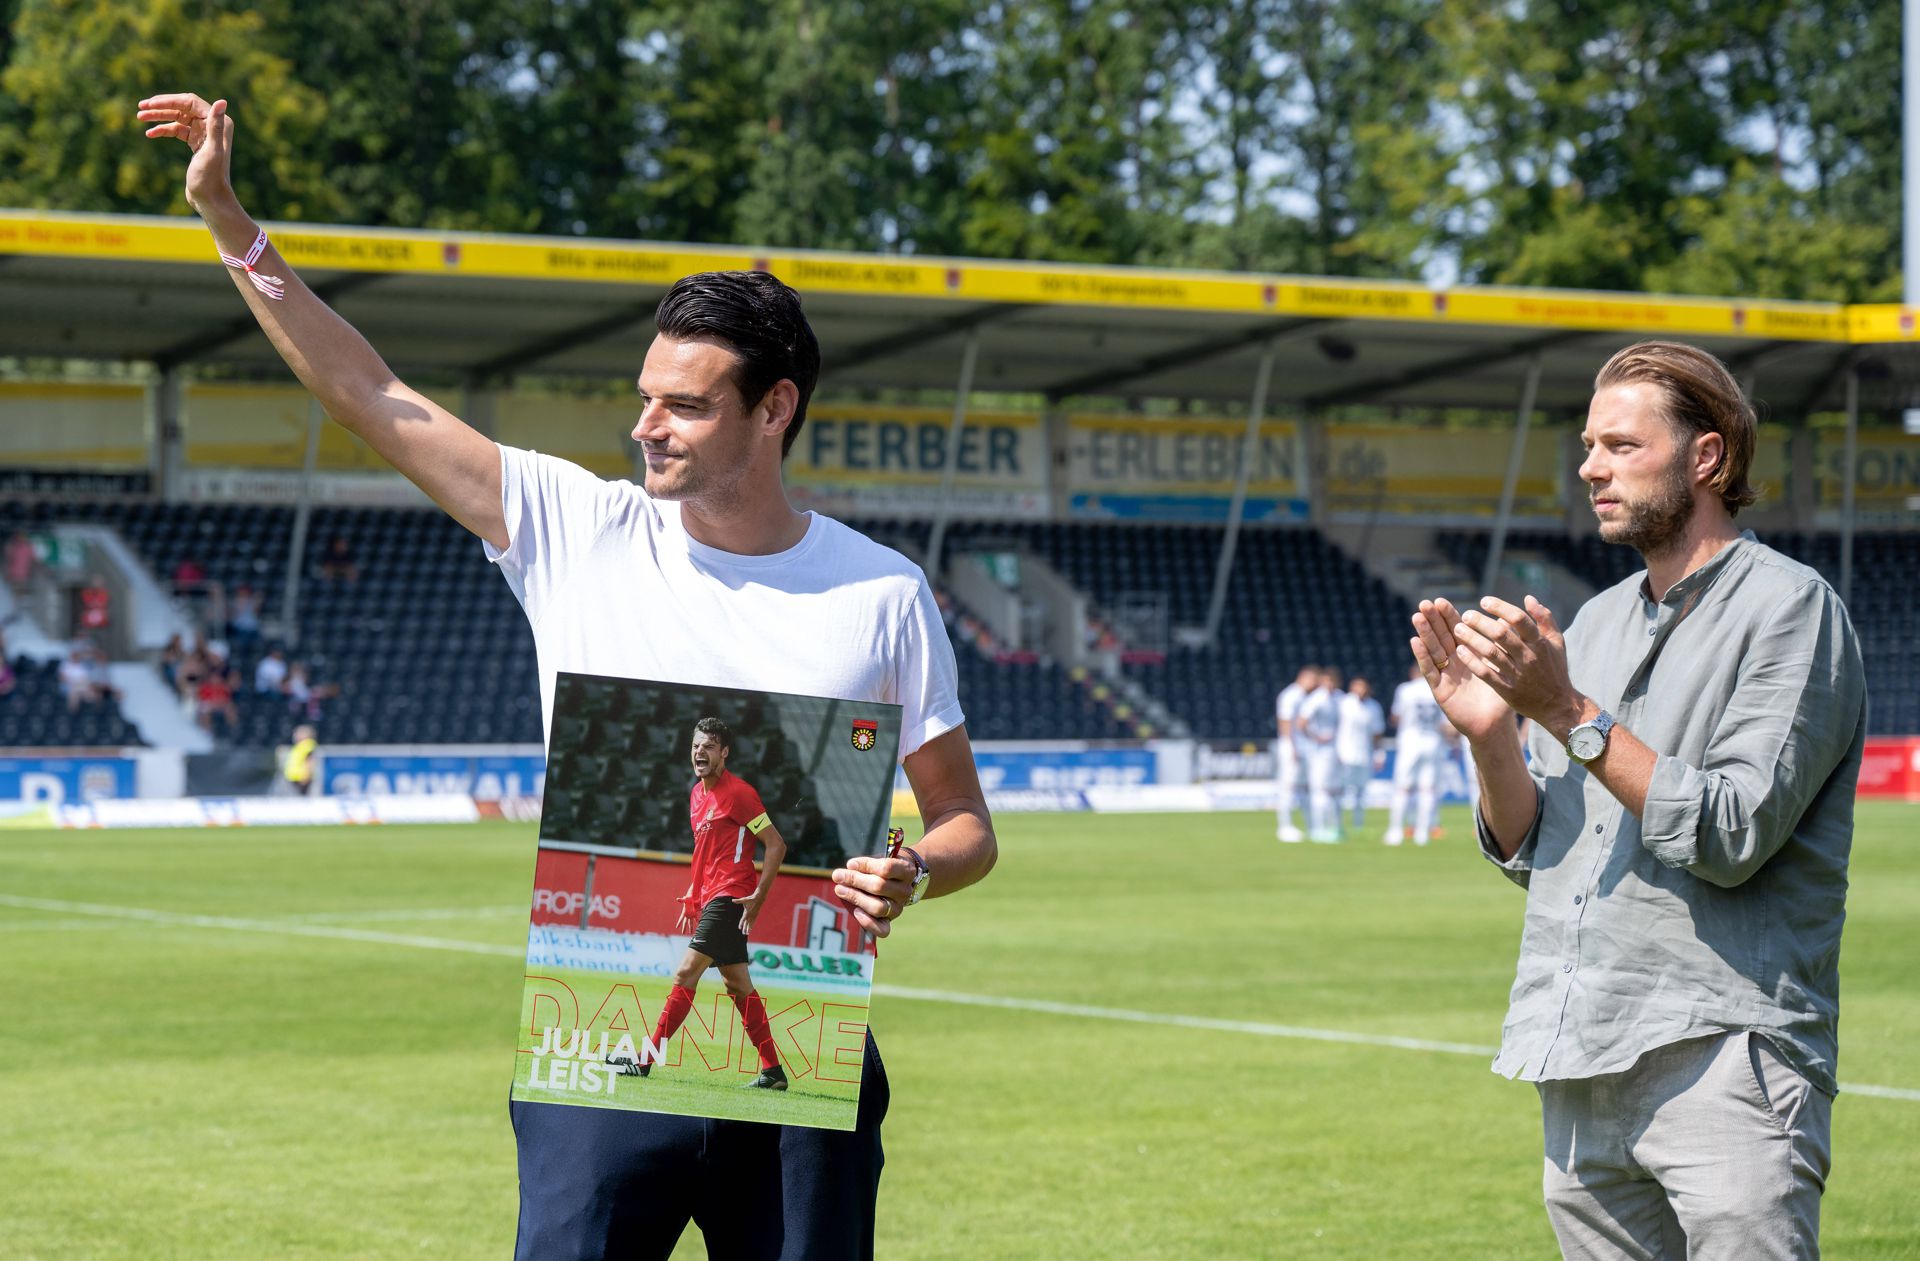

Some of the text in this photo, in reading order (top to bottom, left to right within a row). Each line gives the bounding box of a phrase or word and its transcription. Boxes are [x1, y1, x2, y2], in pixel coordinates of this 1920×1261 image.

[811, 420, 1020, 474] FERBER
[529, 929, 634, 954] olksbank
[751, 949, 864, 978] OLLER
[516, 975, 869, 1084] DANKE
[532, 1026, 668, 1067] JULIAN
[528, 1057, 626, 1096] LEIST
